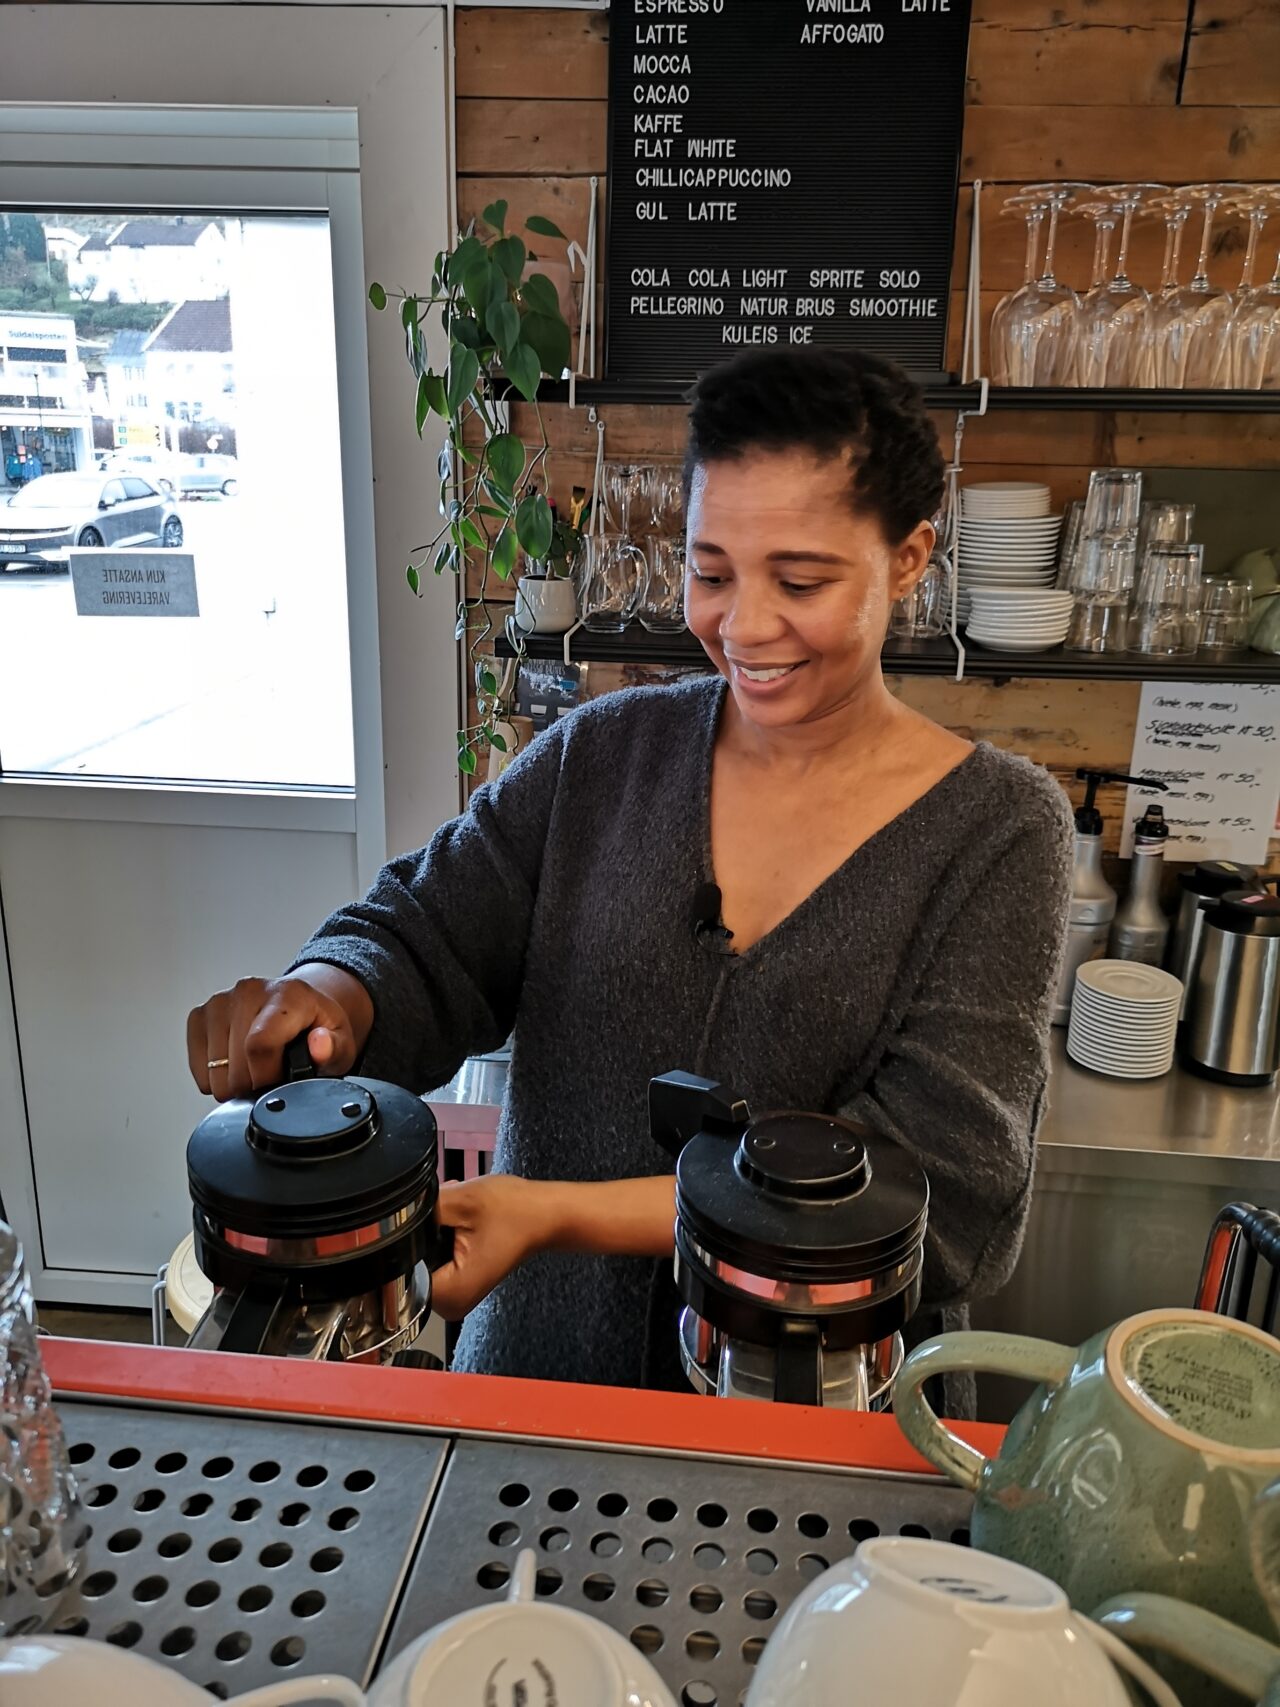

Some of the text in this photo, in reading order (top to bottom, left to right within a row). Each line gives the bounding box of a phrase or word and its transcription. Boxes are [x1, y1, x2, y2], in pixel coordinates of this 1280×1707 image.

[635, 0, 723, 13] ESPRESSO
[807, 0, 950, 12] VANILLA LATTE
[636, 25, 687, 43] LATTE
[801, 24, 884, 43] AFFOGATO
[634, 55, 691, 73] MOCCA
[634, 85, 689, 103] CACAO
[634, 114, 683, 133] KAFFE
[635, 139, 736, 157] FLAT WHITE
[636, 168, 791, 187] CHILLICAPPUCCINO
[636, 202, 736, 220] GUL LATTE
[631, 269, 920, 288] COLA COLA LIGHT SPRITE SOLO
[631, 297, 937, 316] PELLEGRINO NATUR BRUS SMOOTHIE
[723, 326, 813, 344] KULEIS ICE
